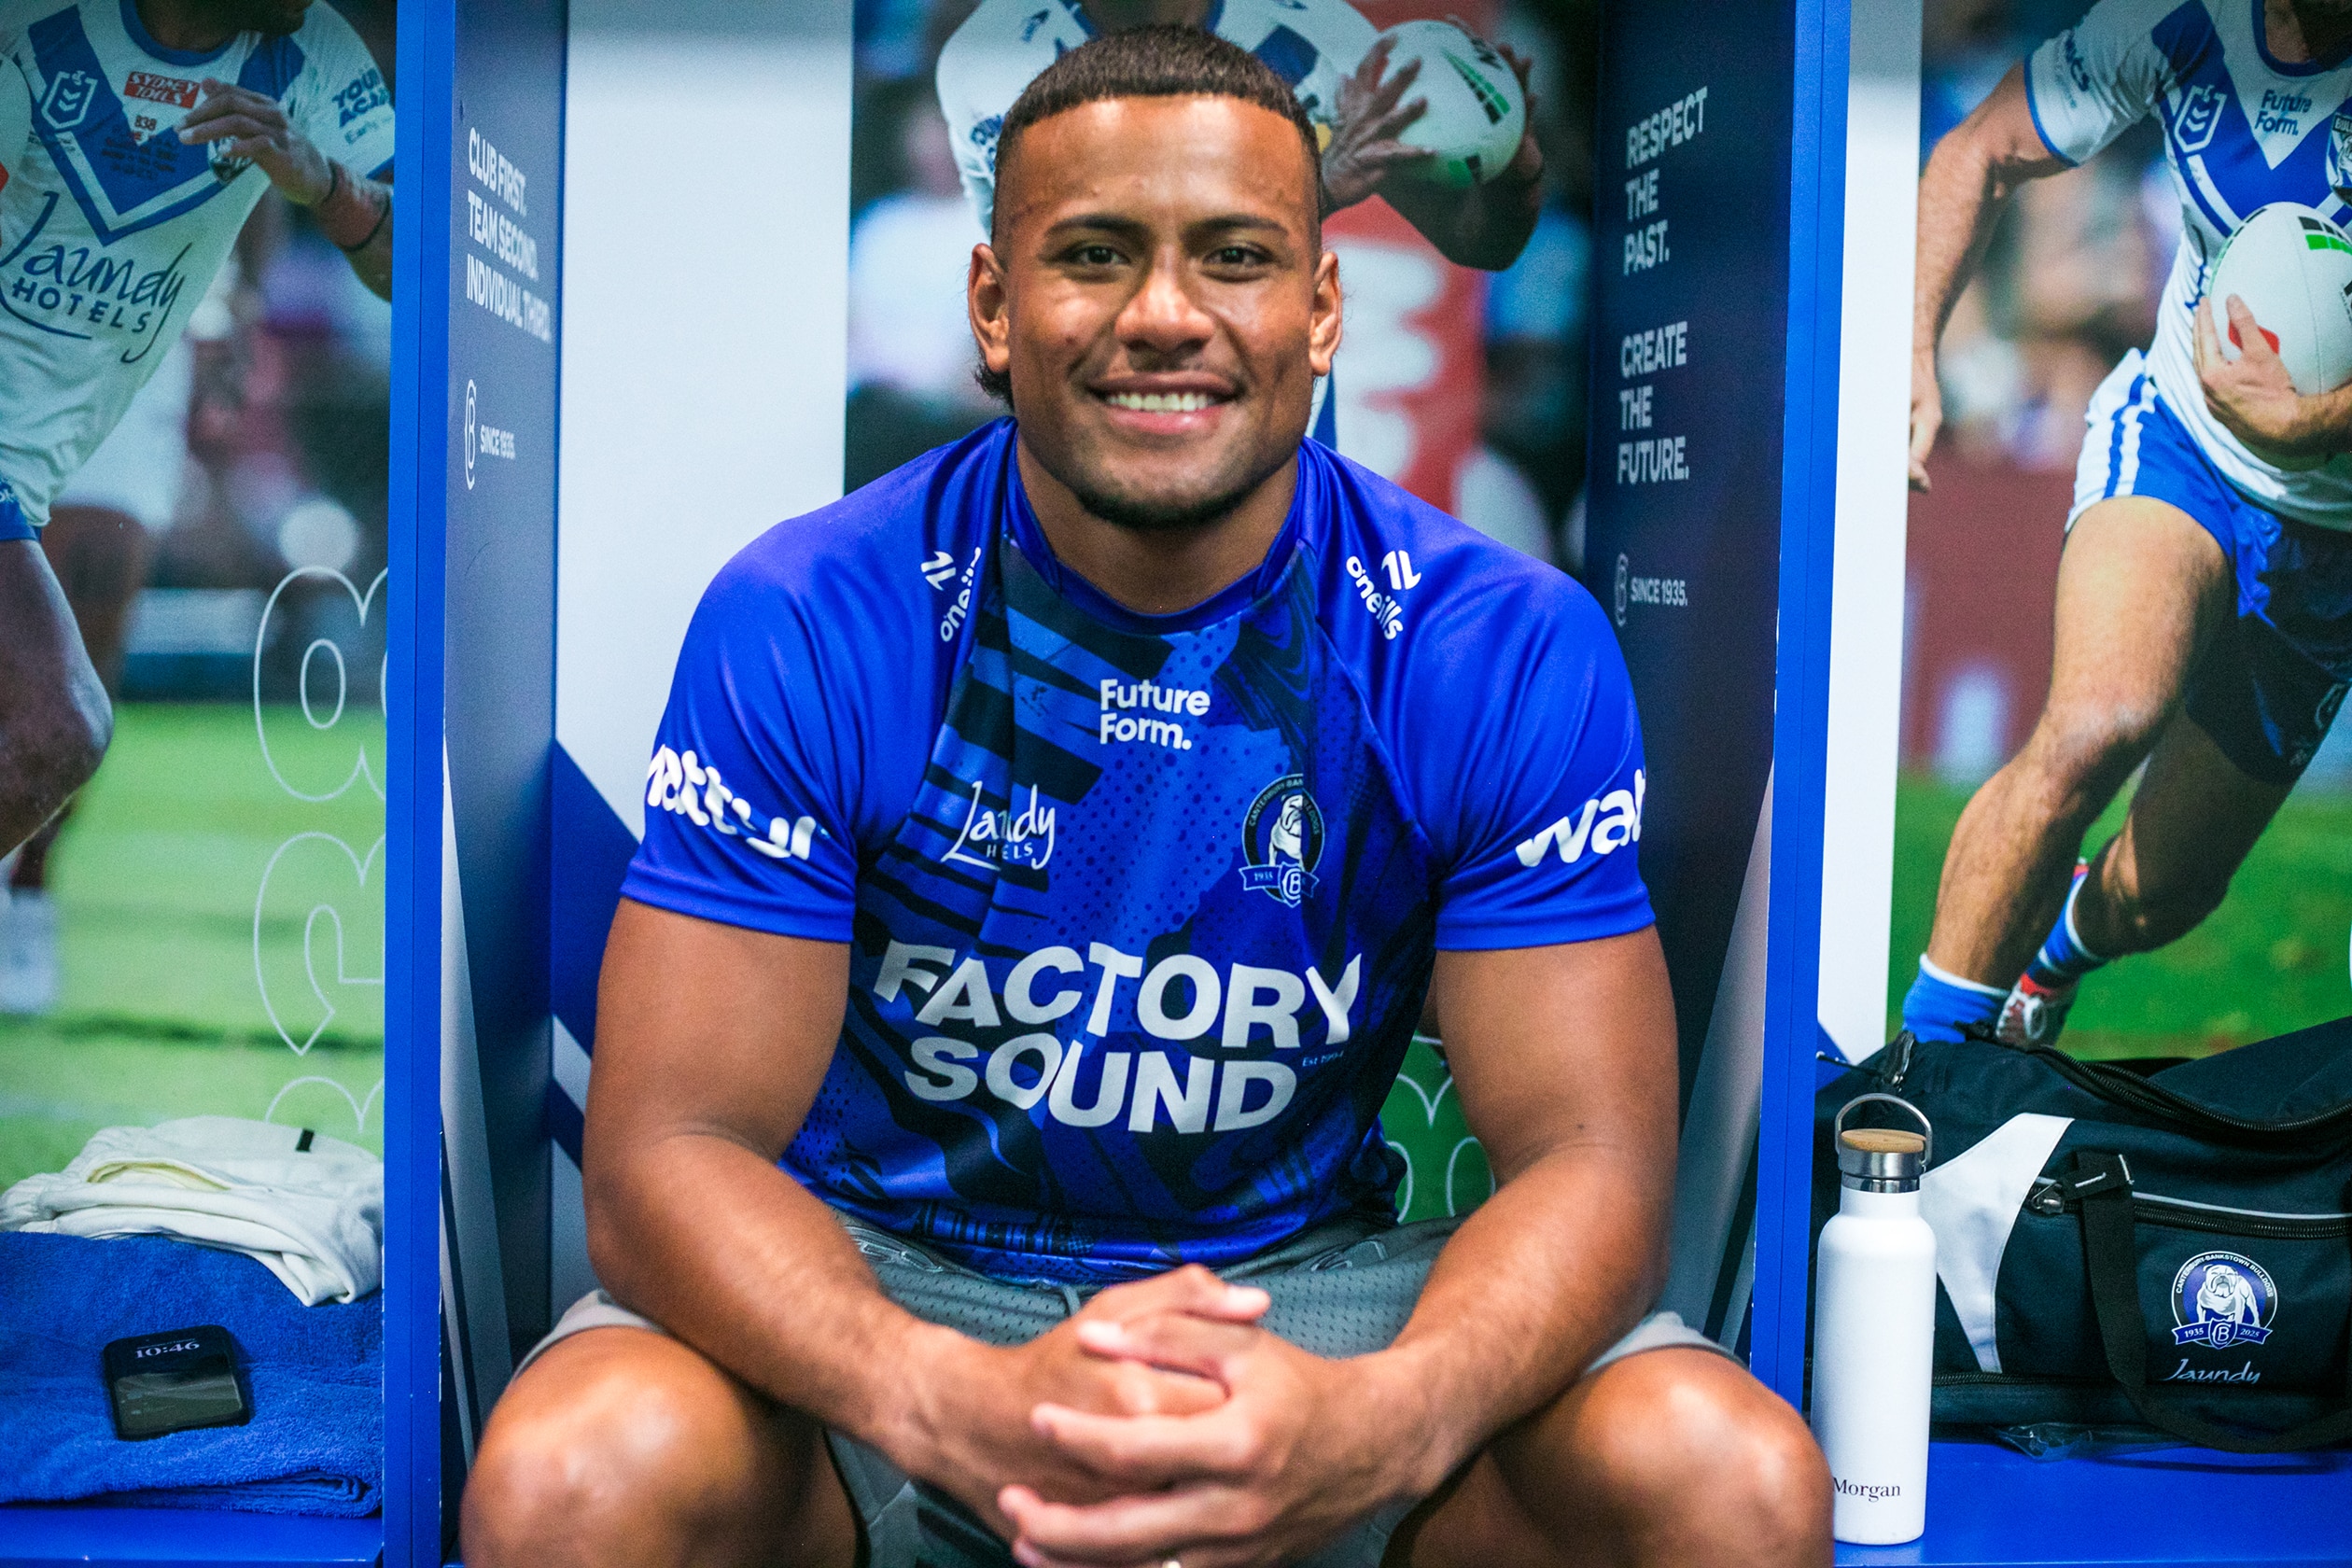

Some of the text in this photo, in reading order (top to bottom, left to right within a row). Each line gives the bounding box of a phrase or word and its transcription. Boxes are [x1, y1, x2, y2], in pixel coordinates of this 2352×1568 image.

[134, 115, 158, 131] 838
[2254, 110, 2299, 136] Form.
[2261, 89, 2312, 113] Future
[1626, 85, 1708, 170] RESPECT
[469, 127, 497, 192] CLUB
[1625, 168, 1659, 222] THE
[468, 189, 497, 254] TEAM
[1624, 219, 1670, 276] PAST.
[0, 190, 192, 363] Laundy
[12, 277, 151, 333] HOTELS
[1620, 320, 1687, 379] CREATE
[1619, 385, 1653, 430] THE
[480, 424, 500, 456] SINCE
[1617, 435, 1690, 485] FUTURE.
[1631, 577, 1660, 604] SINCE
[1100, 679, 1211, 716] Future
[1099, 712, 1192, 750] Form.
[874, 930, 1362, 1048] FACTORY
[903, 1032, 1296, 1135] SOUND
[2248, 1265, 2275, 1298] BULLDOGS
[135, 1341, 200, 1358] 10:46
[2184, 1327, 2205, 1337] 1935
[2240, 1327, 2261, 1337] 2025
[1833, 1477, 1901, 1503] Morgan
